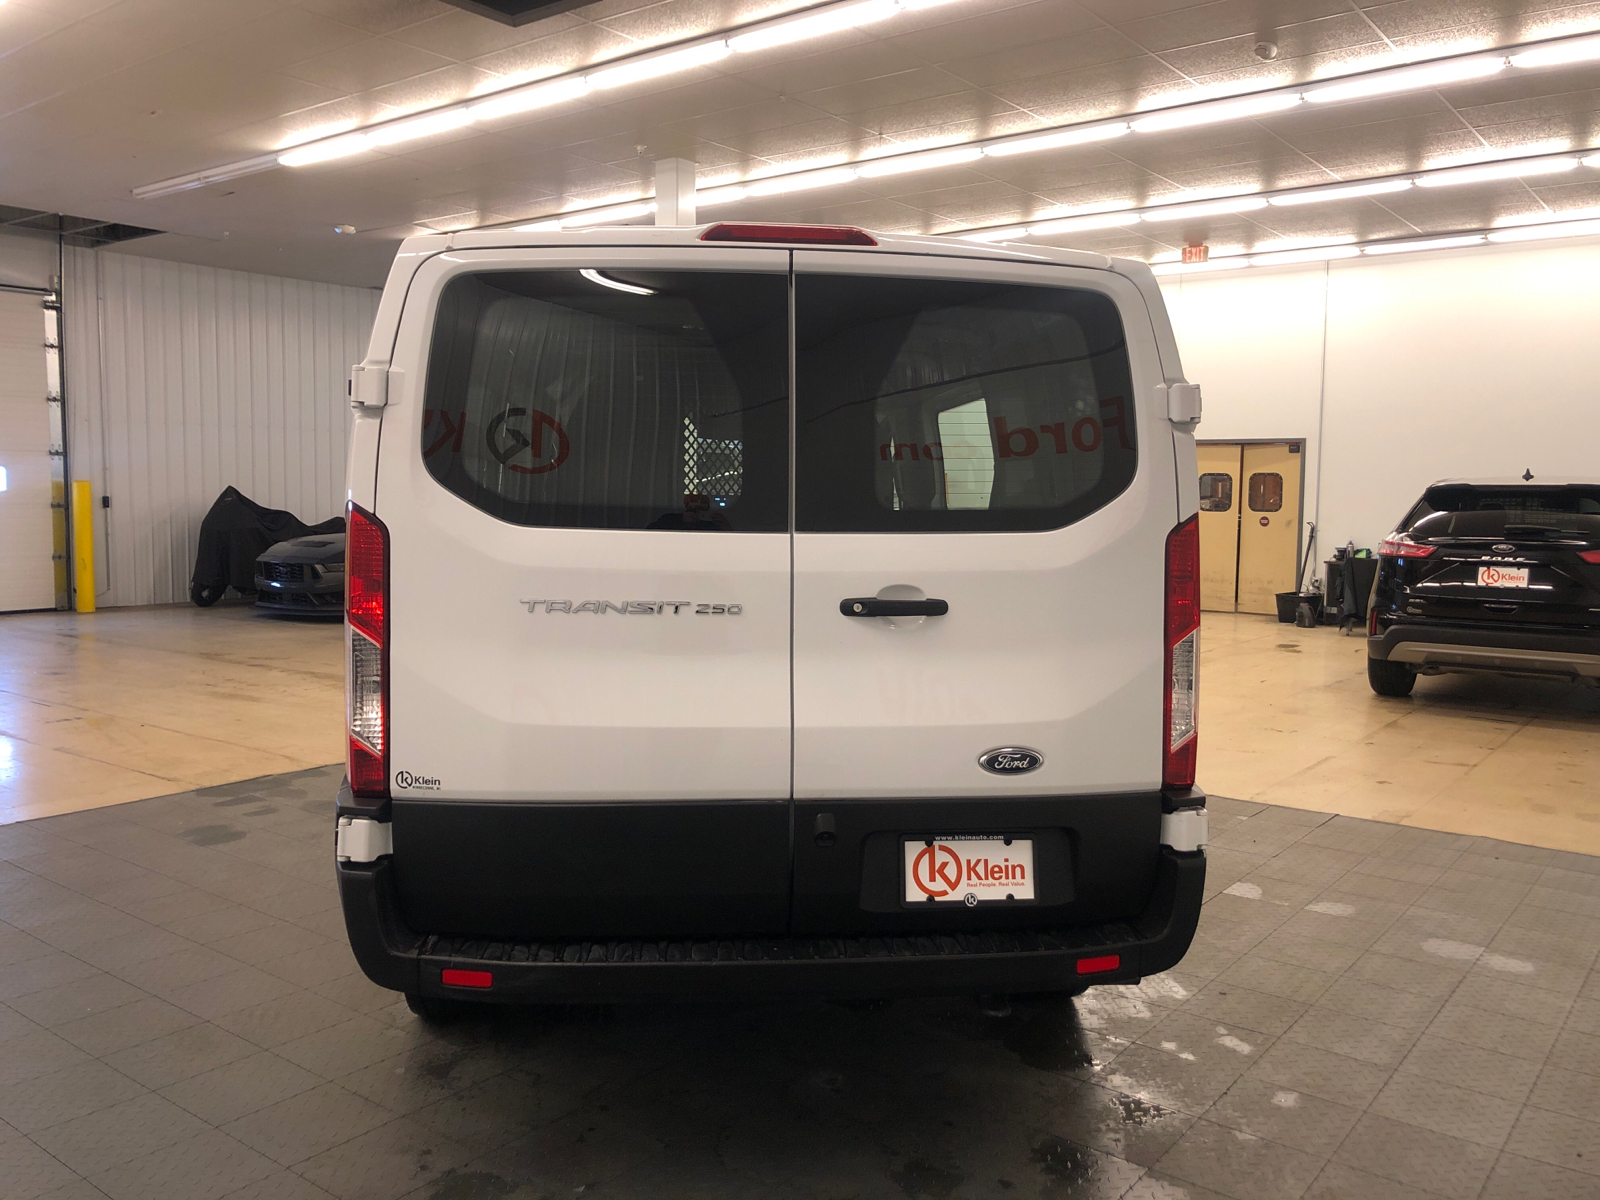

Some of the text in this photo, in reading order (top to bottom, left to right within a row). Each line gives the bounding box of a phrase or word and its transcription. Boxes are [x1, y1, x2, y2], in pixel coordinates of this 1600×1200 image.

[1185, 246, 1205, 262] EXIT
[1501, 573, 1525, 581] Klein
[519, 599, 743, 615] TRANSIT 250
[994, 754, 1030, 769] Ford
[414, 776, 441, 786] Klein
[966, 858, 1026, 881] Klein
